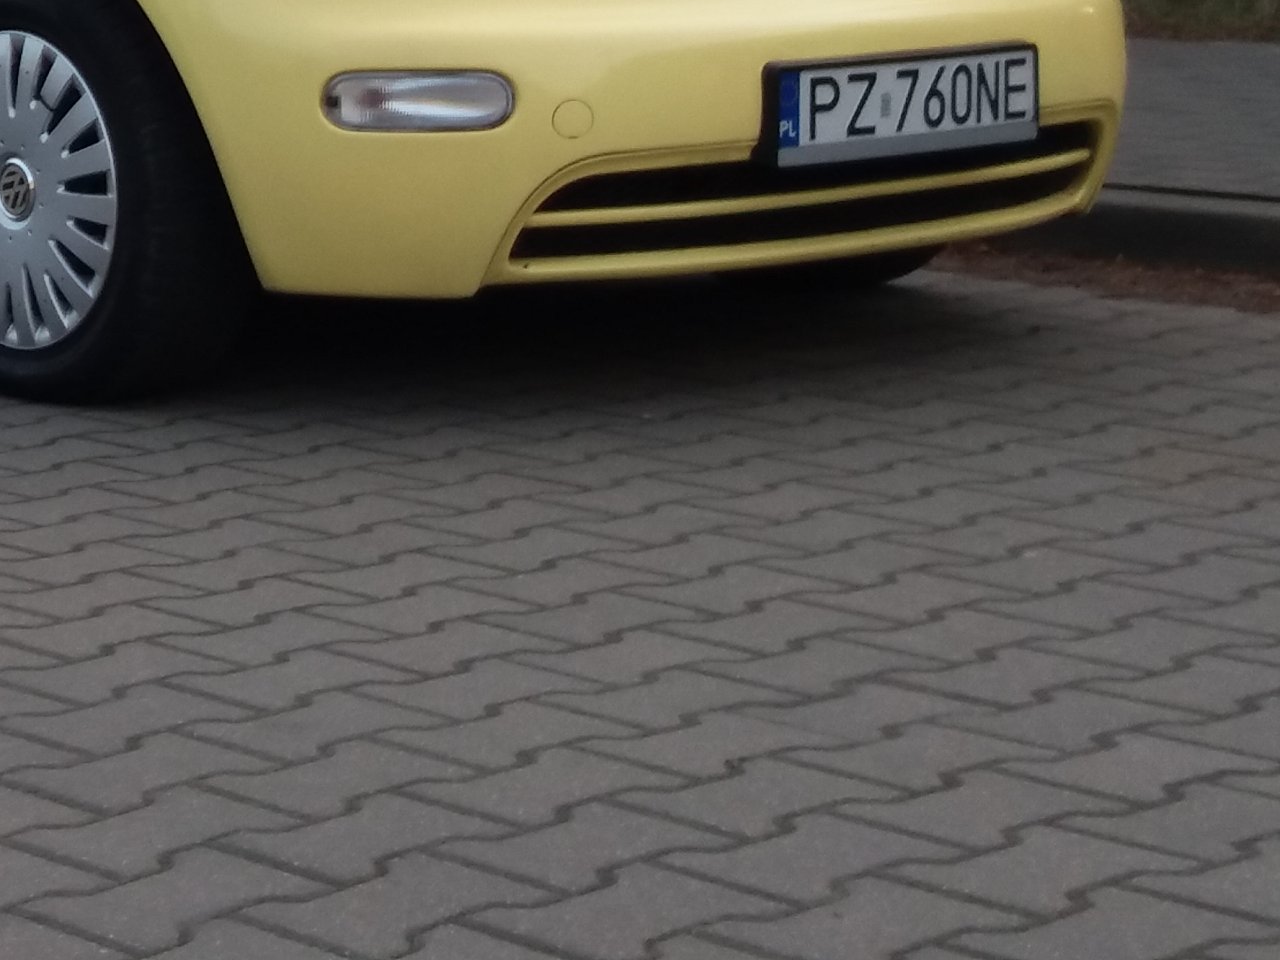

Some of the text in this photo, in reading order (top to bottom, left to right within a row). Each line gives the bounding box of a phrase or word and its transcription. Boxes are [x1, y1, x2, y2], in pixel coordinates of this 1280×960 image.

[808, 57, 1028, 142] PZ 760NE
[778, 119, 797, 139] PL
